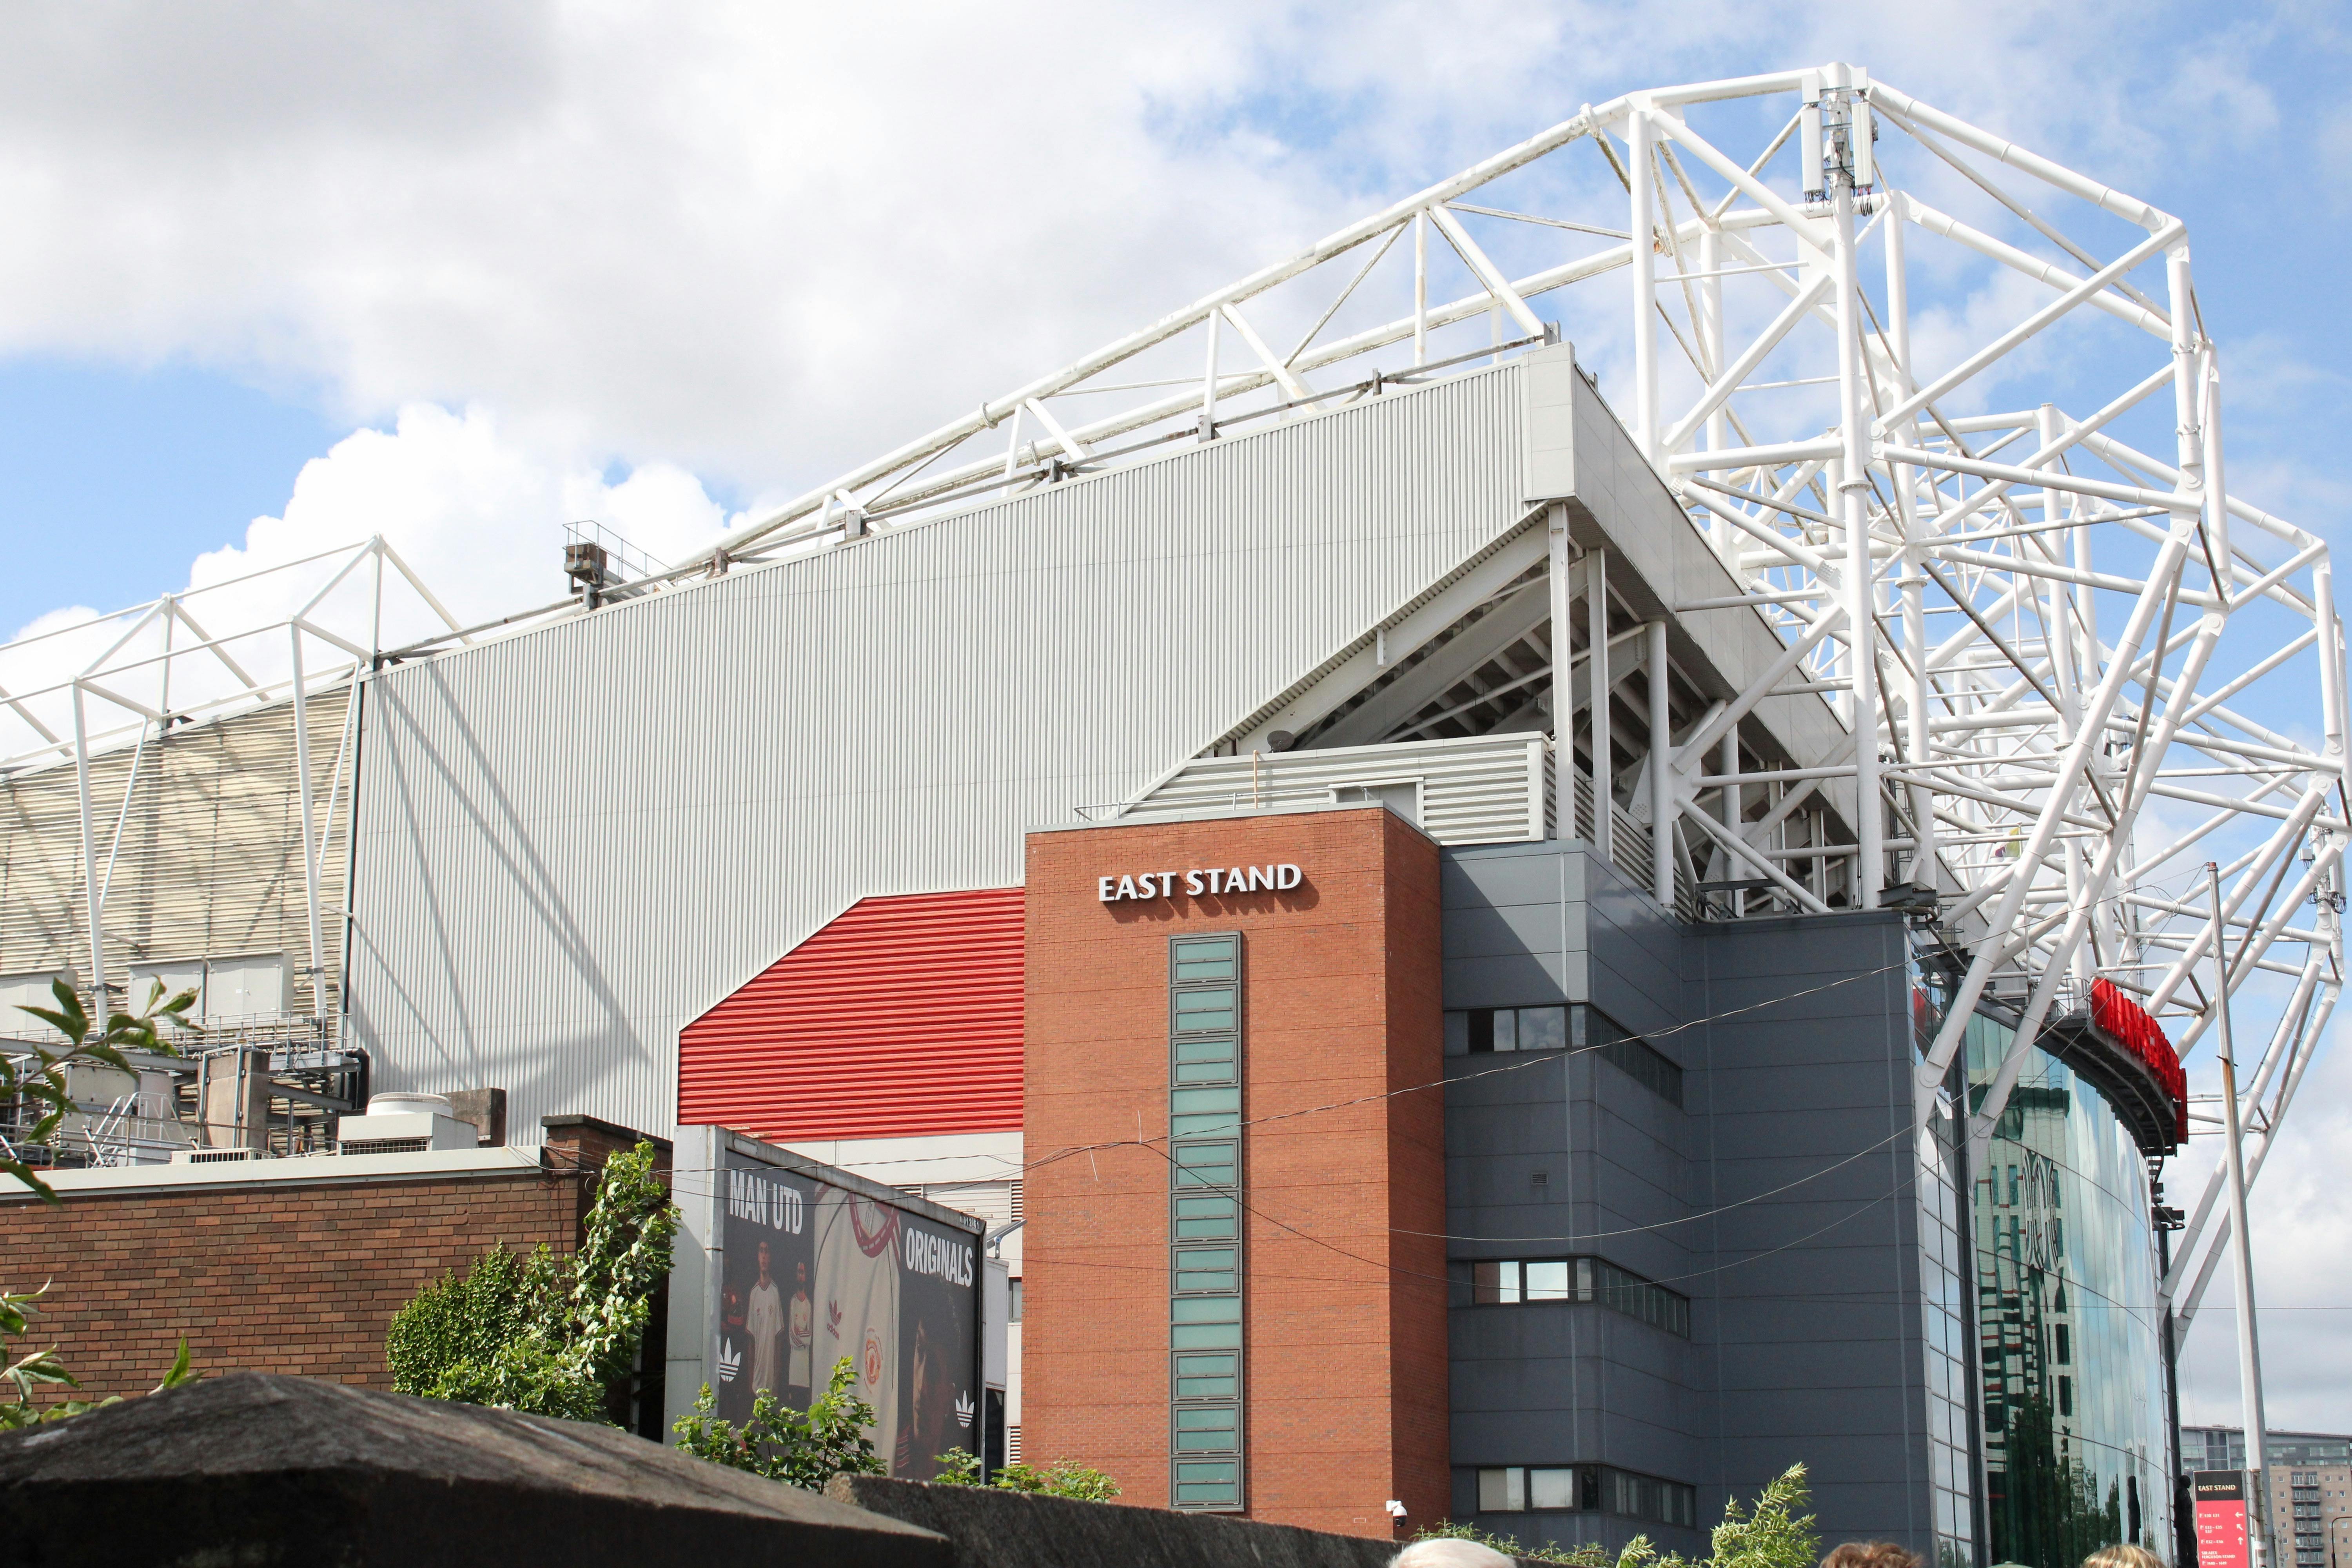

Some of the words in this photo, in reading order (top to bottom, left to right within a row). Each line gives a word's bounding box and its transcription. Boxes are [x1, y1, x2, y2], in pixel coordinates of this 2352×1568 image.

[1099, 871, 1176, 902] EAST
[1186, 864, 1302, 897] STAND
[730, 1170, 767, 1225] MAN
[773, 1183, 803, 1235] UTD
[906, 1227, 973, 1287] ORIGINALS
